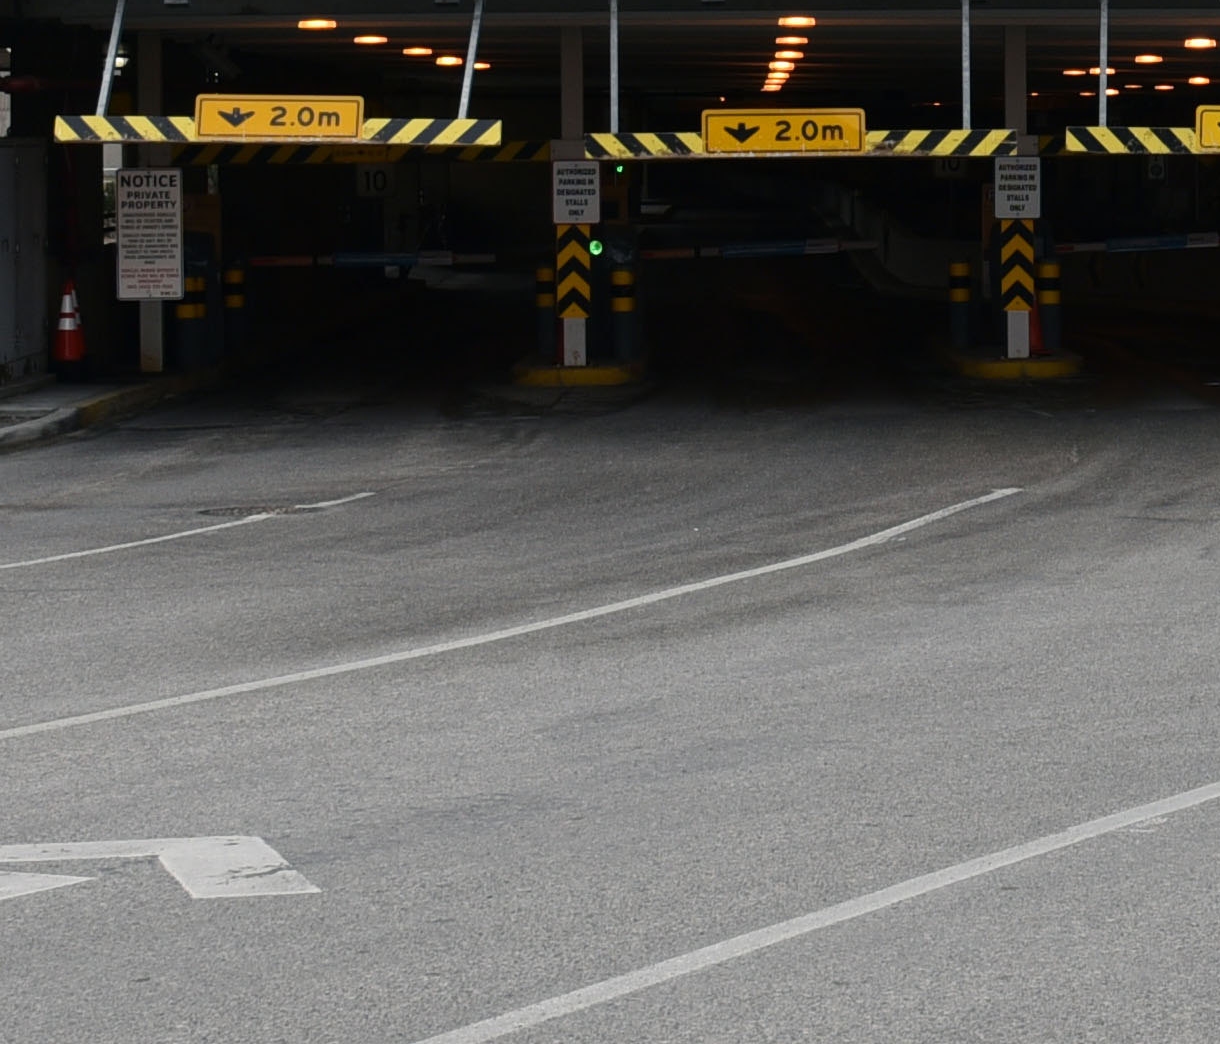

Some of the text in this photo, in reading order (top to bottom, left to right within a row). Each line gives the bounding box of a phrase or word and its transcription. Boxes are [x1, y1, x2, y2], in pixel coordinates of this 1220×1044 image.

[269, 106, 340, 127] 2.0m
[775, 120, 845, 142] 2.0m
[120, 174, 178, 187] NOTICE
[364, 169, 386, 191] 10
[559, 178, 586, 186] PARKING
[127, 190, 171, 199] PRIVATE
[121, 200, 176, 209] PROPERTY
